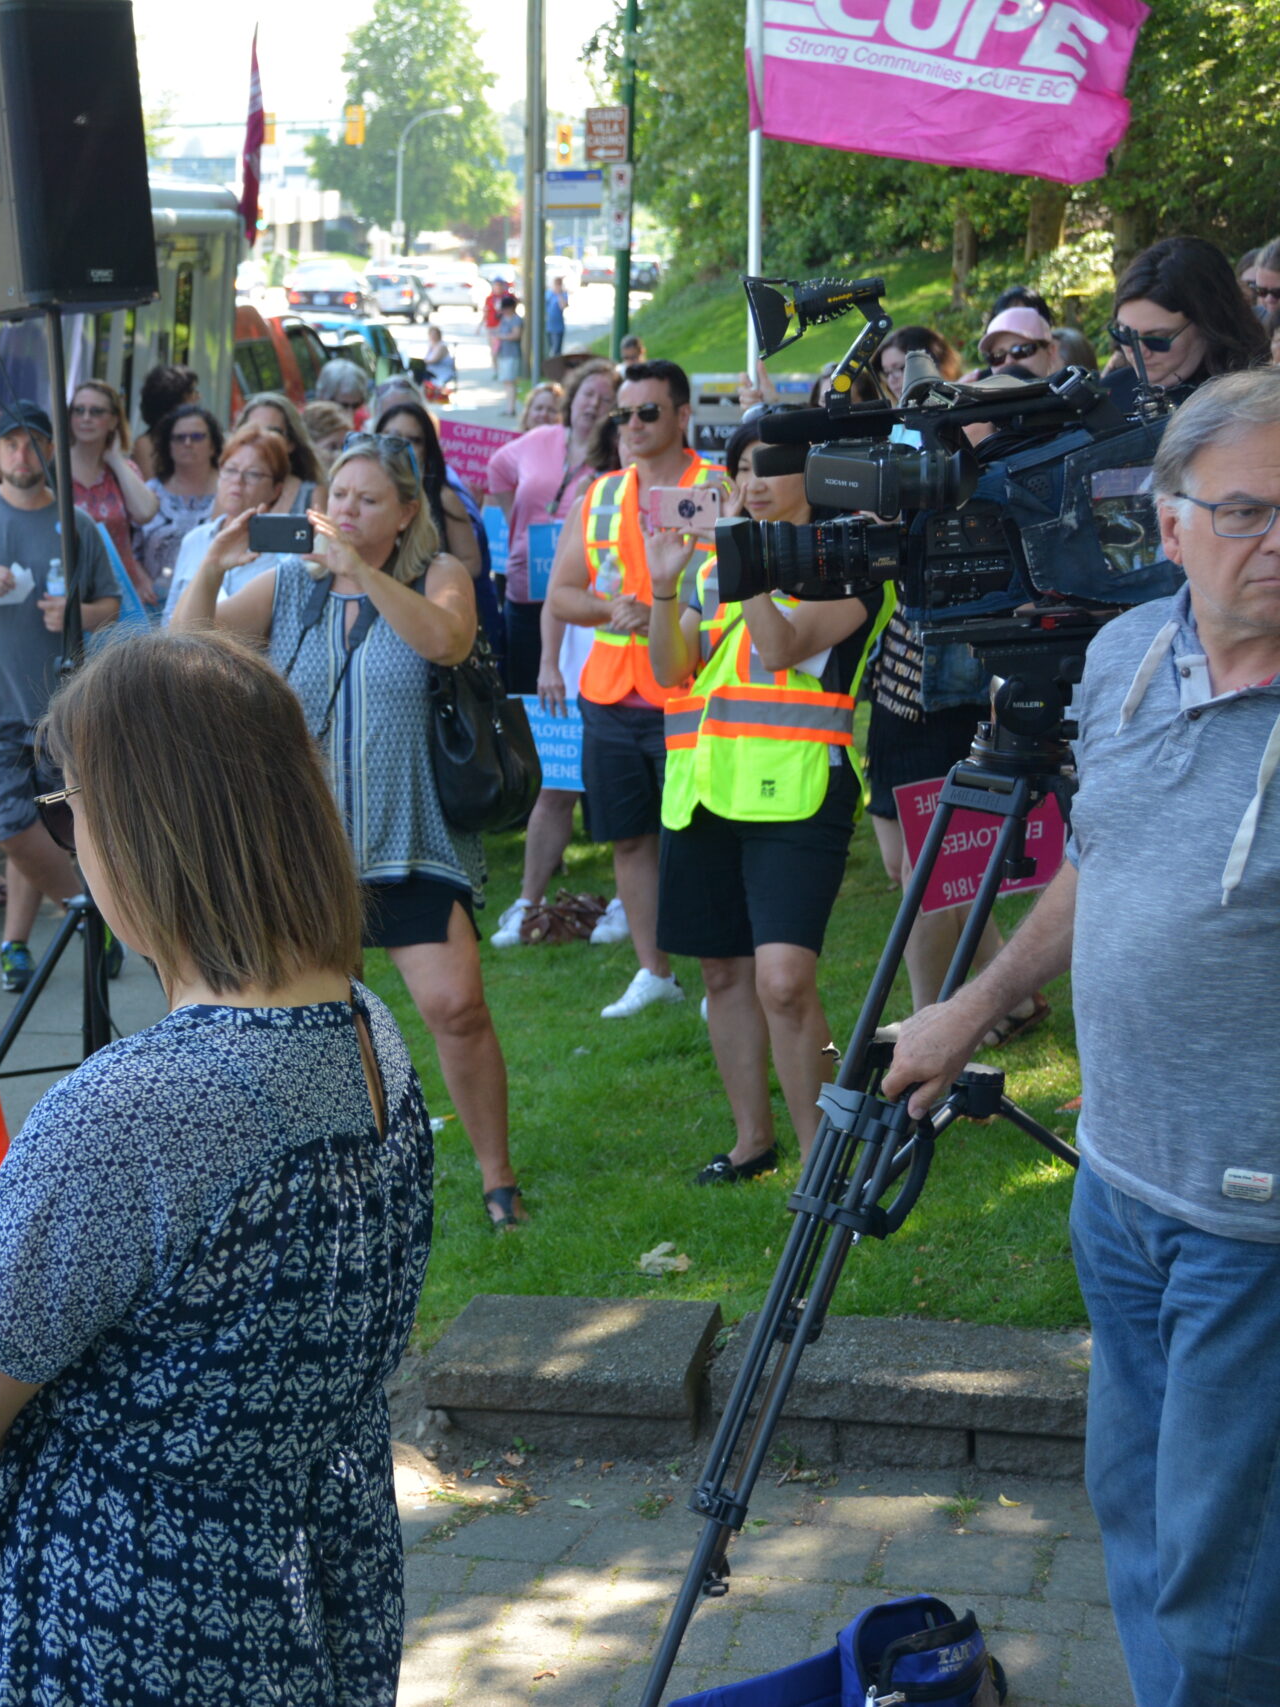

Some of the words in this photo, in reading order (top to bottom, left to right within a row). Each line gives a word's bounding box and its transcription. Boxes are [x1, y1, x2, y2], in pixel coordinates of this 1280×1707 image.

[785, 37, 848, 63] Strong
[853, 46, 962, 84] Communities
[978, 71, 1032, 95] CUPE
[1036, 80, 1070, 98] BC
[591, 122, 621, 134] VILLA
[586, 134, 626, 147] CASINO
[543, 762, 581, 780] BENE
[942, 876, 976, 901] 1816
